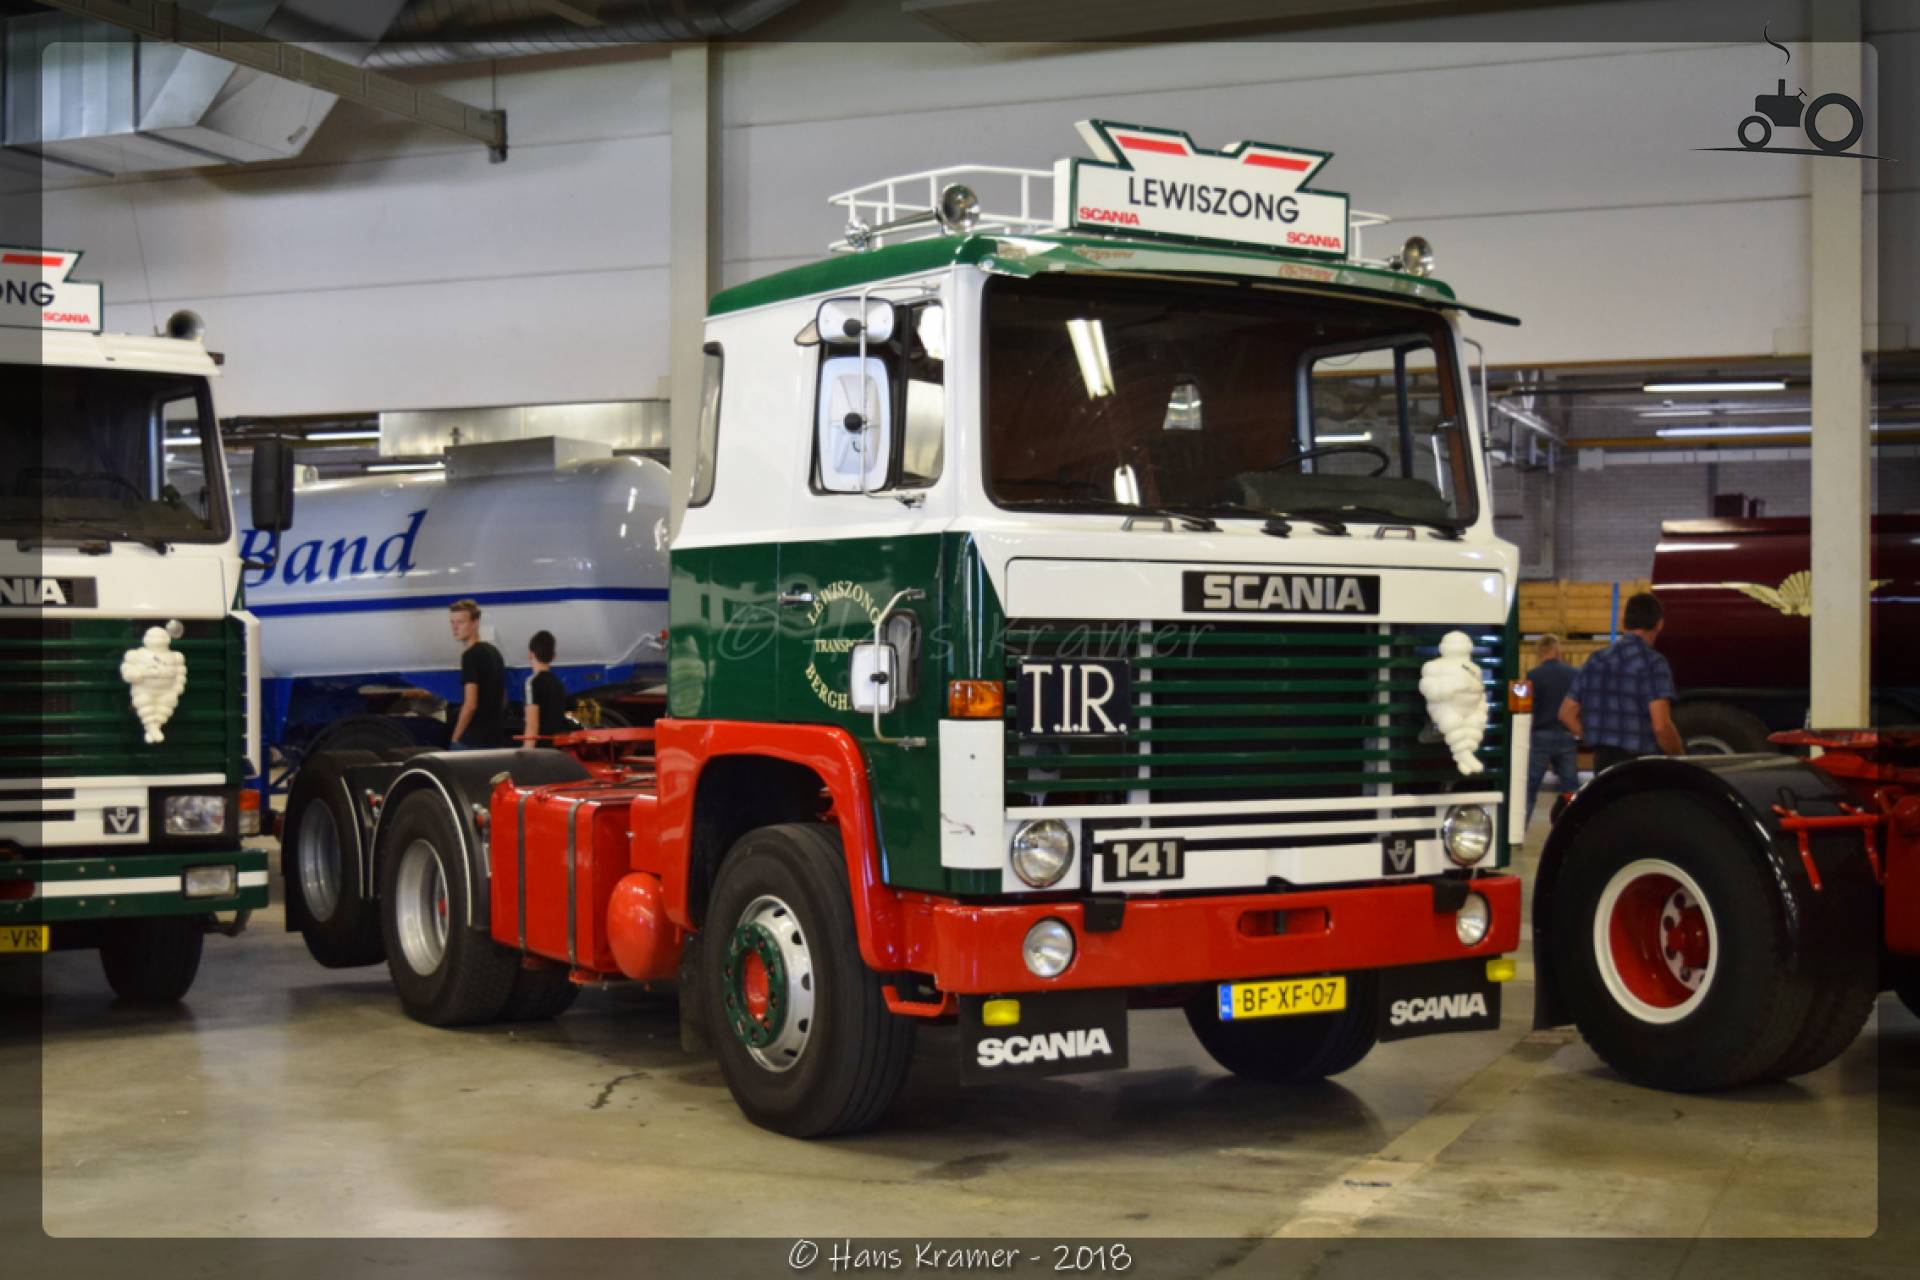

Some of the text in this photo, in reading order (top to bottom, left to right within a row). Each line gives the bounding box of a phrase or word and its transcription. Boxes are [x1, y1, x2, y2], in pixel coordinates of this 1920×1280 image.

[1079, 207, 1140, 226] SCANIA
[1128, 176, 1299, 224] LEWISZONG
[1286, 231, 1341, 249] SCANIA
[0, 279, 54, 306] NG
[43, 311, 90, 324] SCANIA
[240, 509, 429, 588] Band
[1203, 574, 1367, 611] SCANIA
[1022, 664, 1128, 734] T.I.R.
[1112, 842, 1179, 878] 141
[1242, 981, 1338, 1012] BF-XF-07
[1389, 992, 1488, 1026] SCANIA
[976, 1028, 1112, 1068] SCANIA
